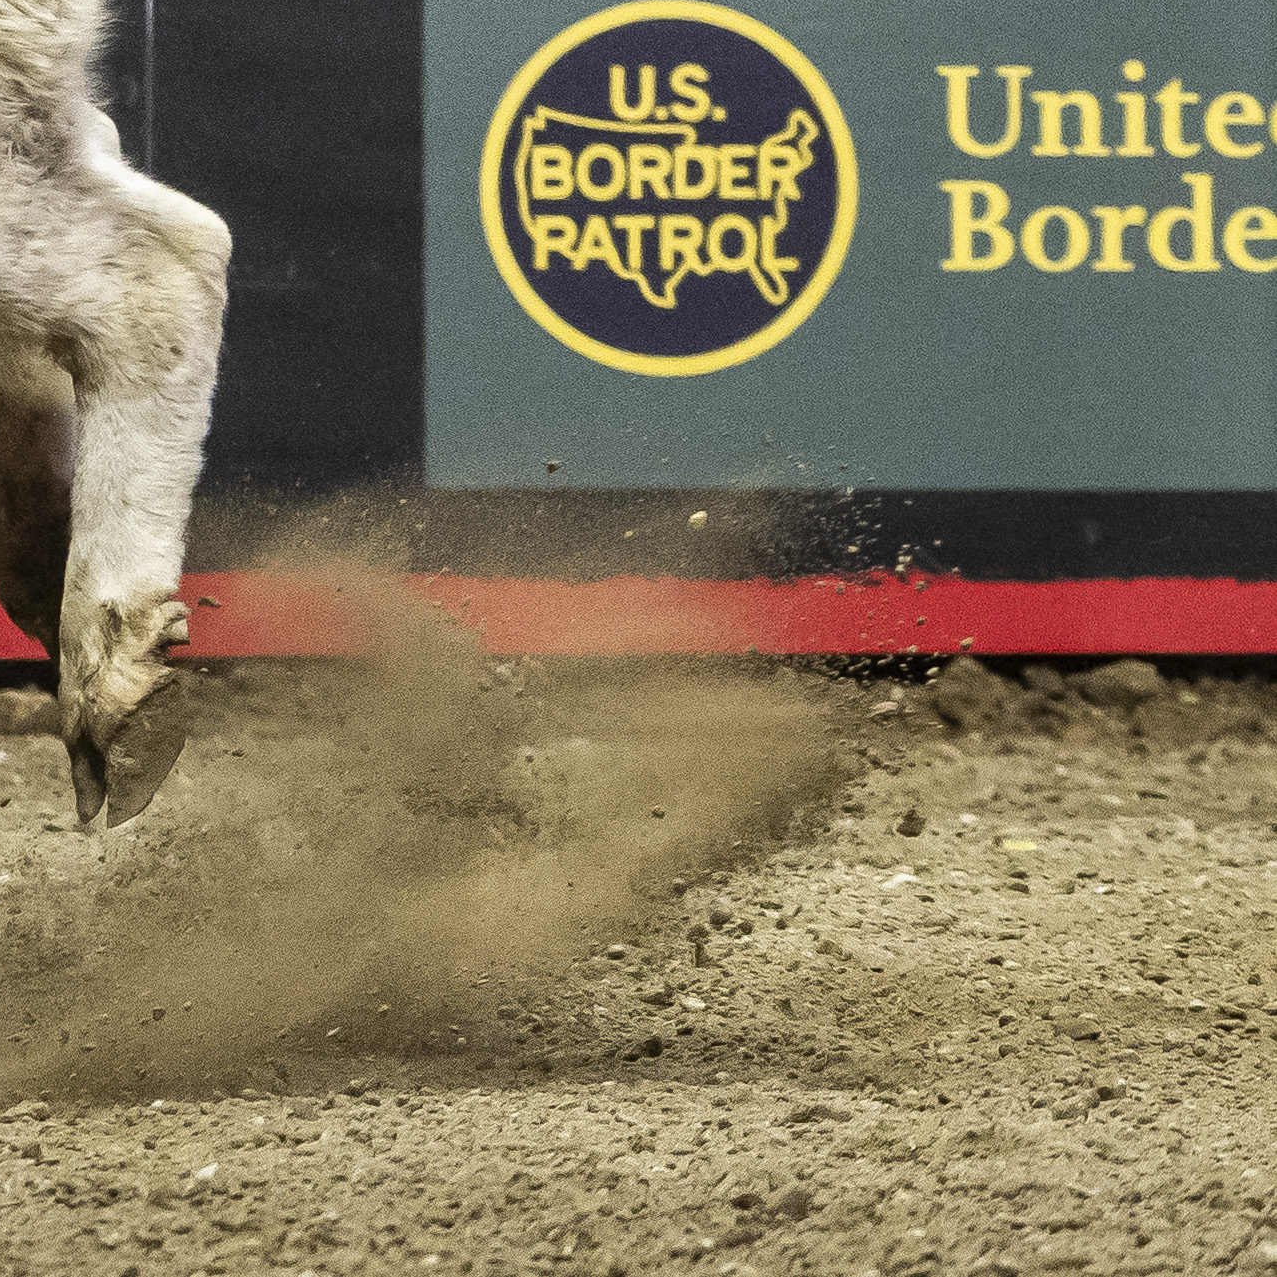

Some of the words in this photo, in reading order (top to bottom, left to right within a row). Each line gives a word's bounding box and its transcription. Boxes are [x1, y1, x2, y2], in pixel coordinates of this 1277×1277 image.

[609, 62, 727, 122] U.S.
[936, 59, 1277, 159] Unite
[531, 142, 802, 201] BORDER
[532, 213, 800, 272] PATROL
